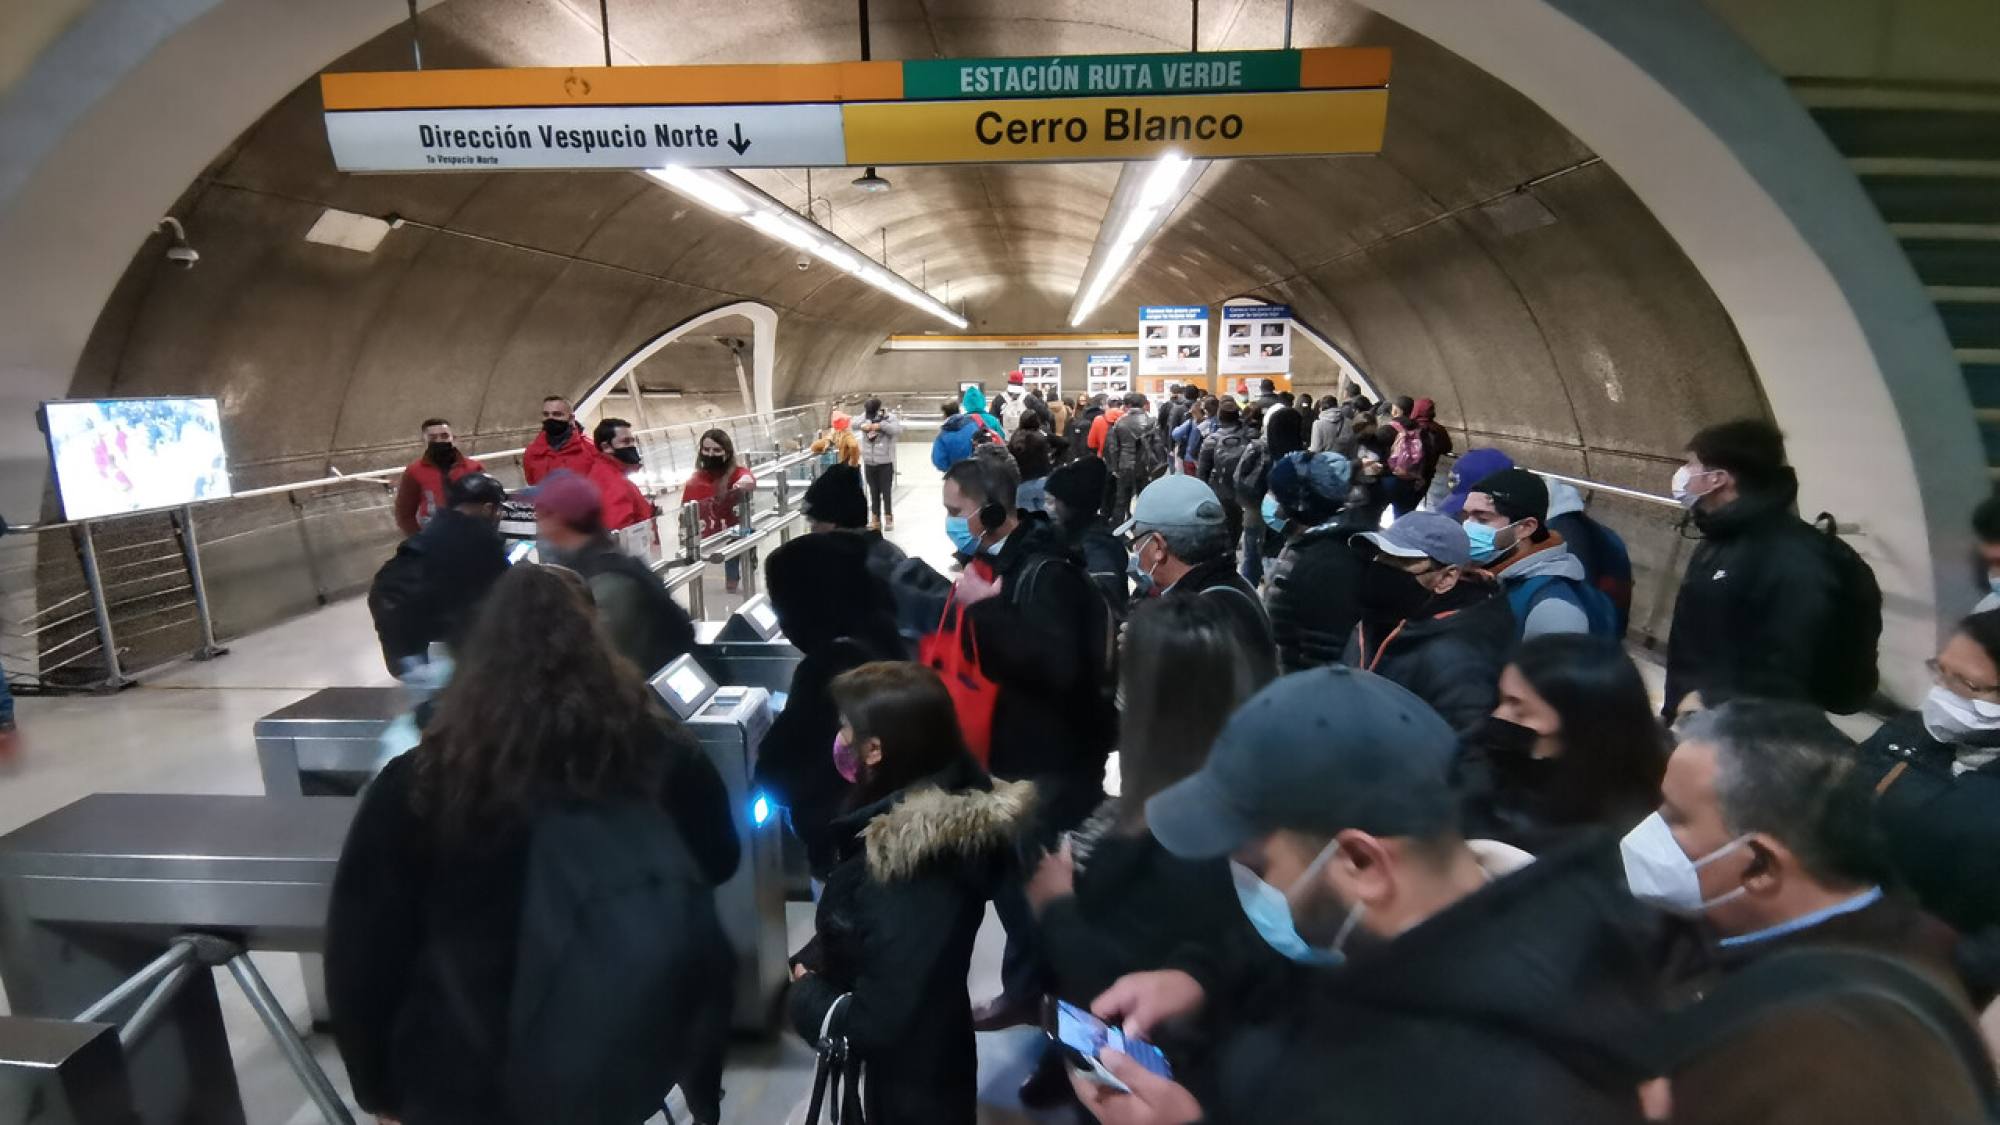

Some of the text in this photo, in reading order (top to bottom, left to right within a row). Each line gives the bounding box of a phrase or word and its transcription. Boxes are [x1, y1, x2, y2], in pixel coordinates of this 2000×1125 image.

[960, 58, 1242, 93] ESTACIÓN RUTA VERDE
[418, 124, 719, 153] Dirección Vespucio Norte
[975, 107, 1243, 145] Cerro Blanco
[437, 155, 474, 165] Vespucio
